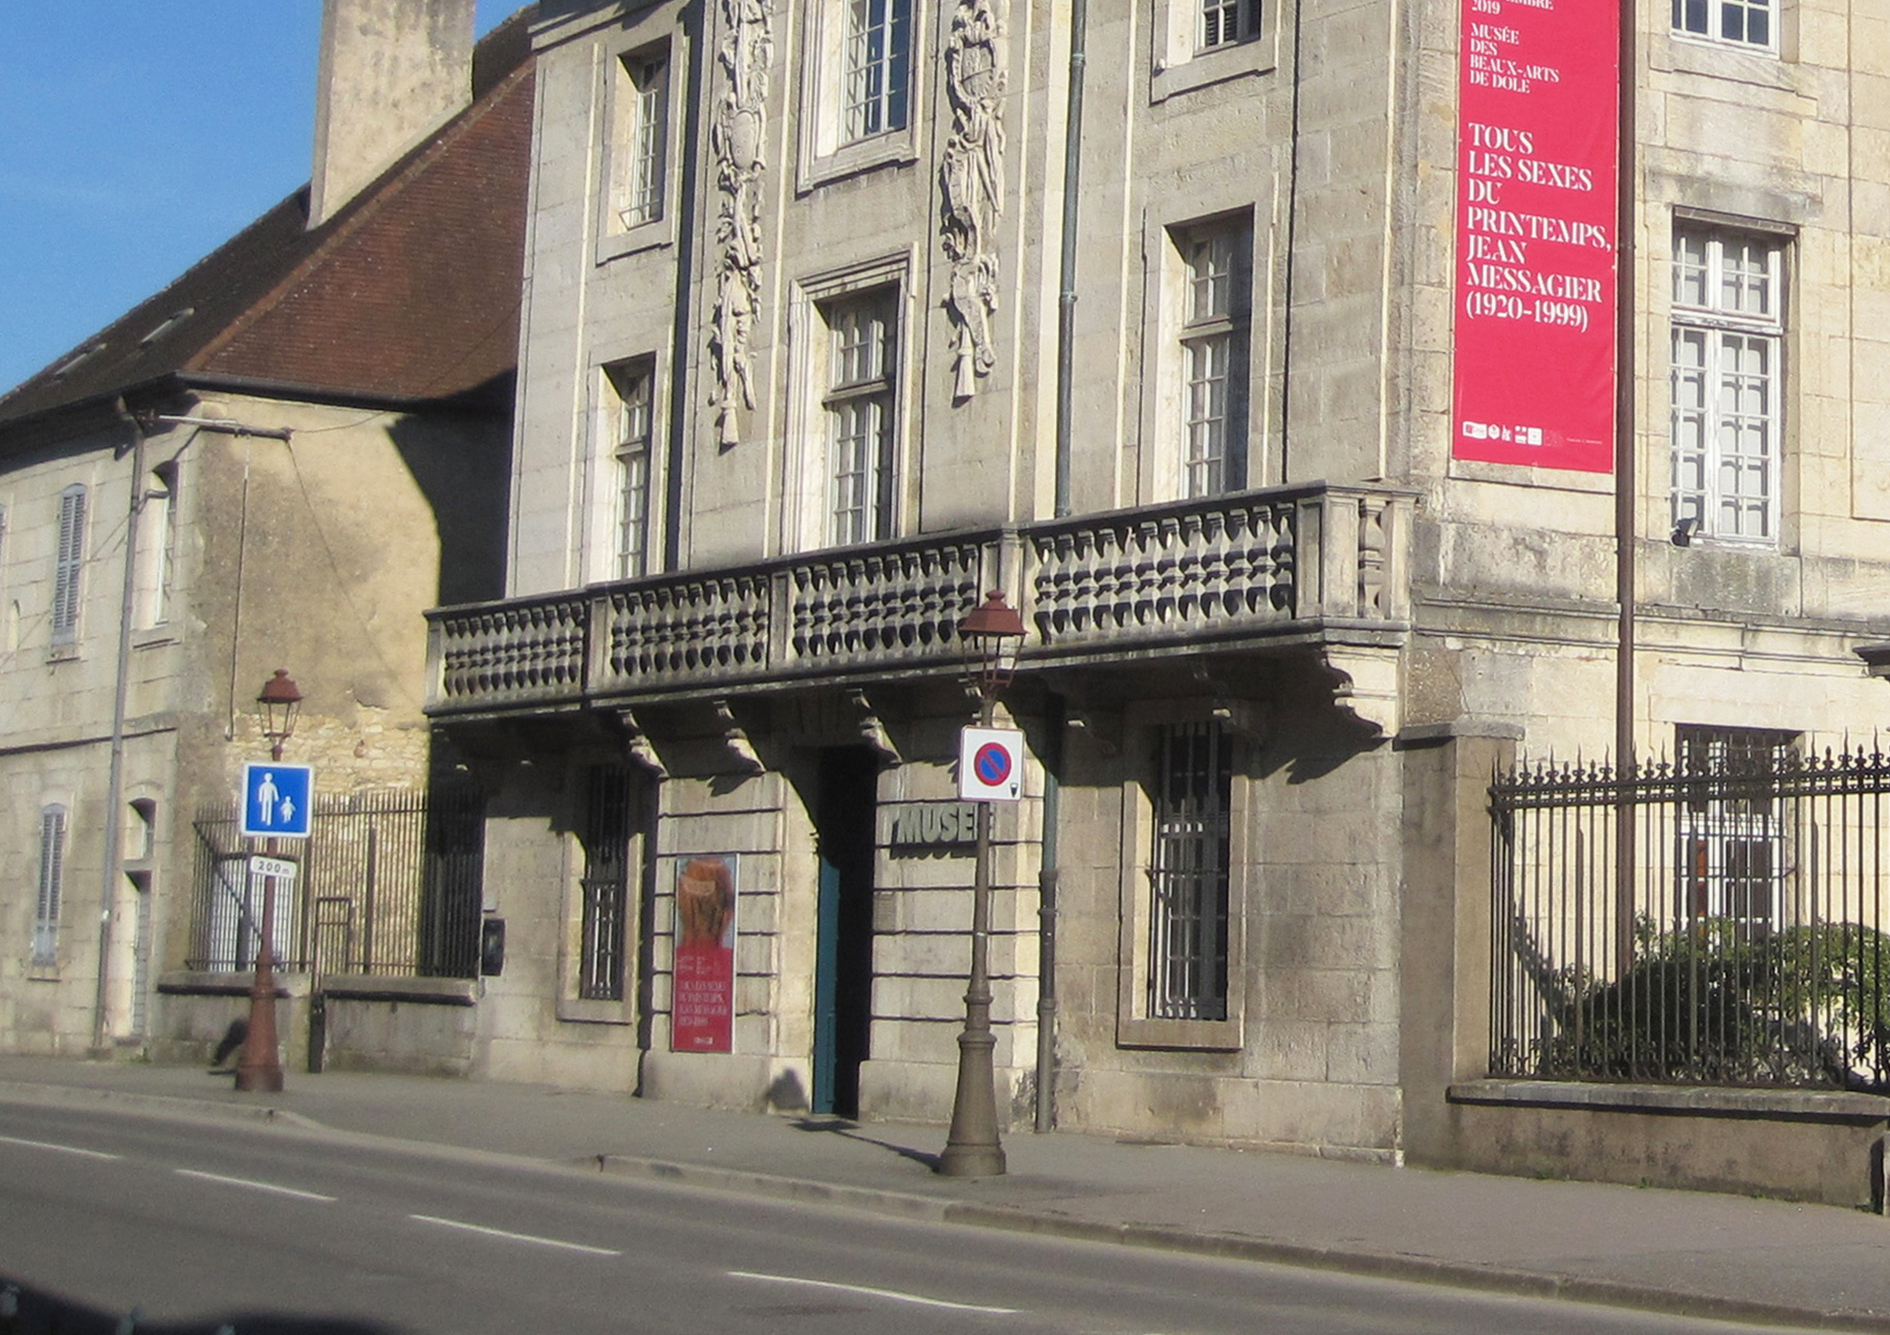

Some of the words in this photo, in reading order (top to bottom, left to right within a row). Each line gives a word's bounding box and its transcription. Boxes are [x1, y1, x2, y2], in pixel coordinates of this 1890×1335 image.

[1470, 38, 1498, 56] DES
[1471, 23, 1519, 44] MUSÉE
[1470, 54, 1560, 83] BEAUX-ARTS
[1470, 70, 1489, 86] DE
[1492, 74, 1530, 93] DOLE
[1468, 122, 1533, 154] TOUS
[1468, 150, 1512, 179] LES
[1518, 158, 1592, 192] SEXES
[1468, 178, 1502, 205] DU
[1467, 206, 1612, 252] PRINTEMPS,
[1466, 234, 1527, 264] JEAN
[1466, 262, 1603, 303] MESSAGIER
[1466, 291, 1588, 333] (1920-1999)
